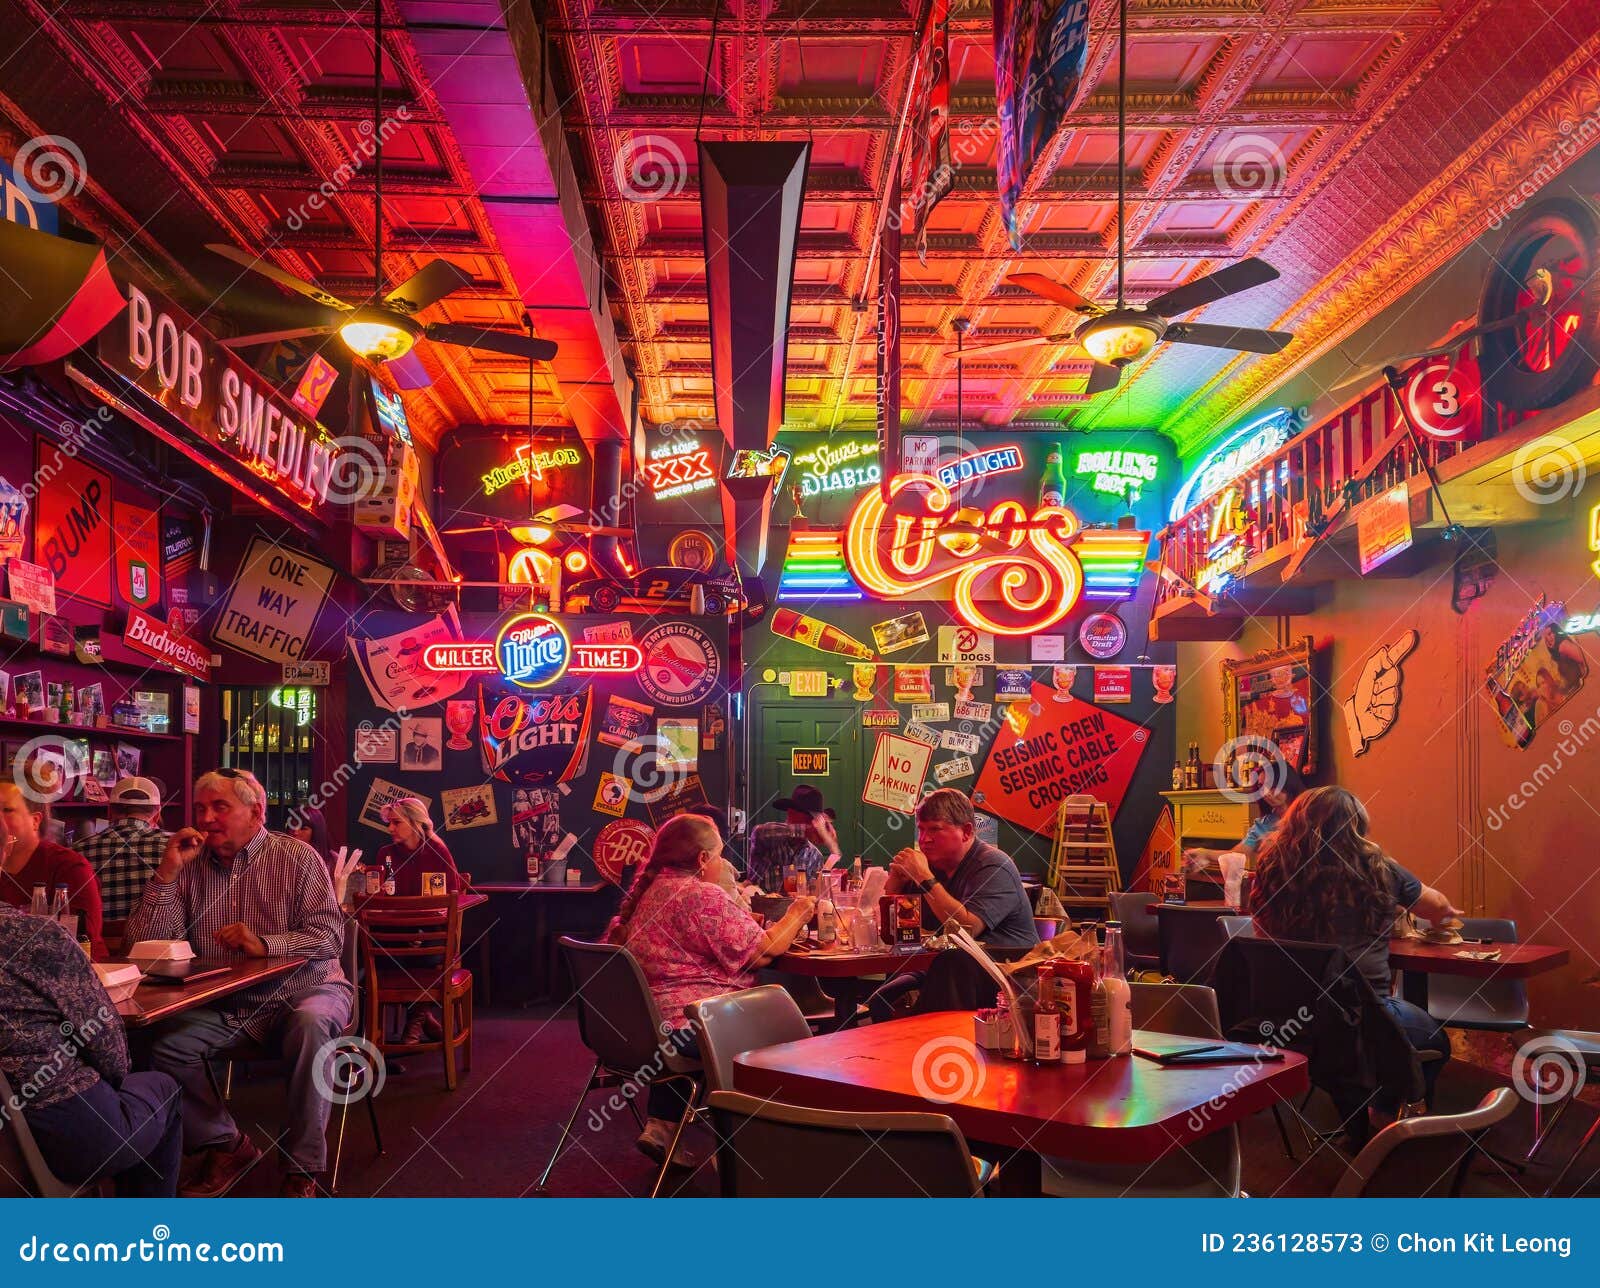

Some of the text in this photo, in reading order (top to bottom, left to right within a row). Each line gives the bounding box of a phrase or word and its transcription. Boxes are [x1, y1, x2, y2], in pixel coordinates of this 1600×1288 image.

[129, 283, 203, 409] BOB
[219, 367, 338, 506] SMEDLEY
[1432, 381, 1459, 416] 3
[904, 456, 937, 466] PARKING
[914, 442, 928, 453] NO
[649, 451, 713, 488] XX
[802, 465, 881, 496] DIABLO
[940, 449, 1017, 488] BUD LIGHT
[1077, 451, 1158, 480] ROLLING
[42, 479, 103, 582] BUMP
[268, 556, 310, 587] ONE
[258, 585, 298, 617] WAY
[646, 580, 670, 597] 2
[18, 607, 27, 622] Rd
[128, 615, 210, 673] Budweiser
[226, 609, 303, 656] TRAFFIC
[435, 649, 493, 666] MILLER
[577, 649, 628, 668] TIME!
[644, 625, 716, 683] AMERICAN OWNED
[960, 653, 991, 662] DOGS
[796, 670, 823, 693] EXIT
[484, 695, 582, 739] Coors
[608, 725, 638, 740] CLAMATO
[494, 723, 578, 769] LIGHT
[993, 712, 1106, 772] SEISMIC CREW
[794, 752, 827, 769] KEEP OUT
[888, 755, 912, 774] NO
[1000, 733, 1119, 795] SEISMIC CABLE
[872, 773, 917, 795] PARKING
[1028, 764, 1110, 810] CROSSING
[1153, 850, 1171, 869] ROAD
